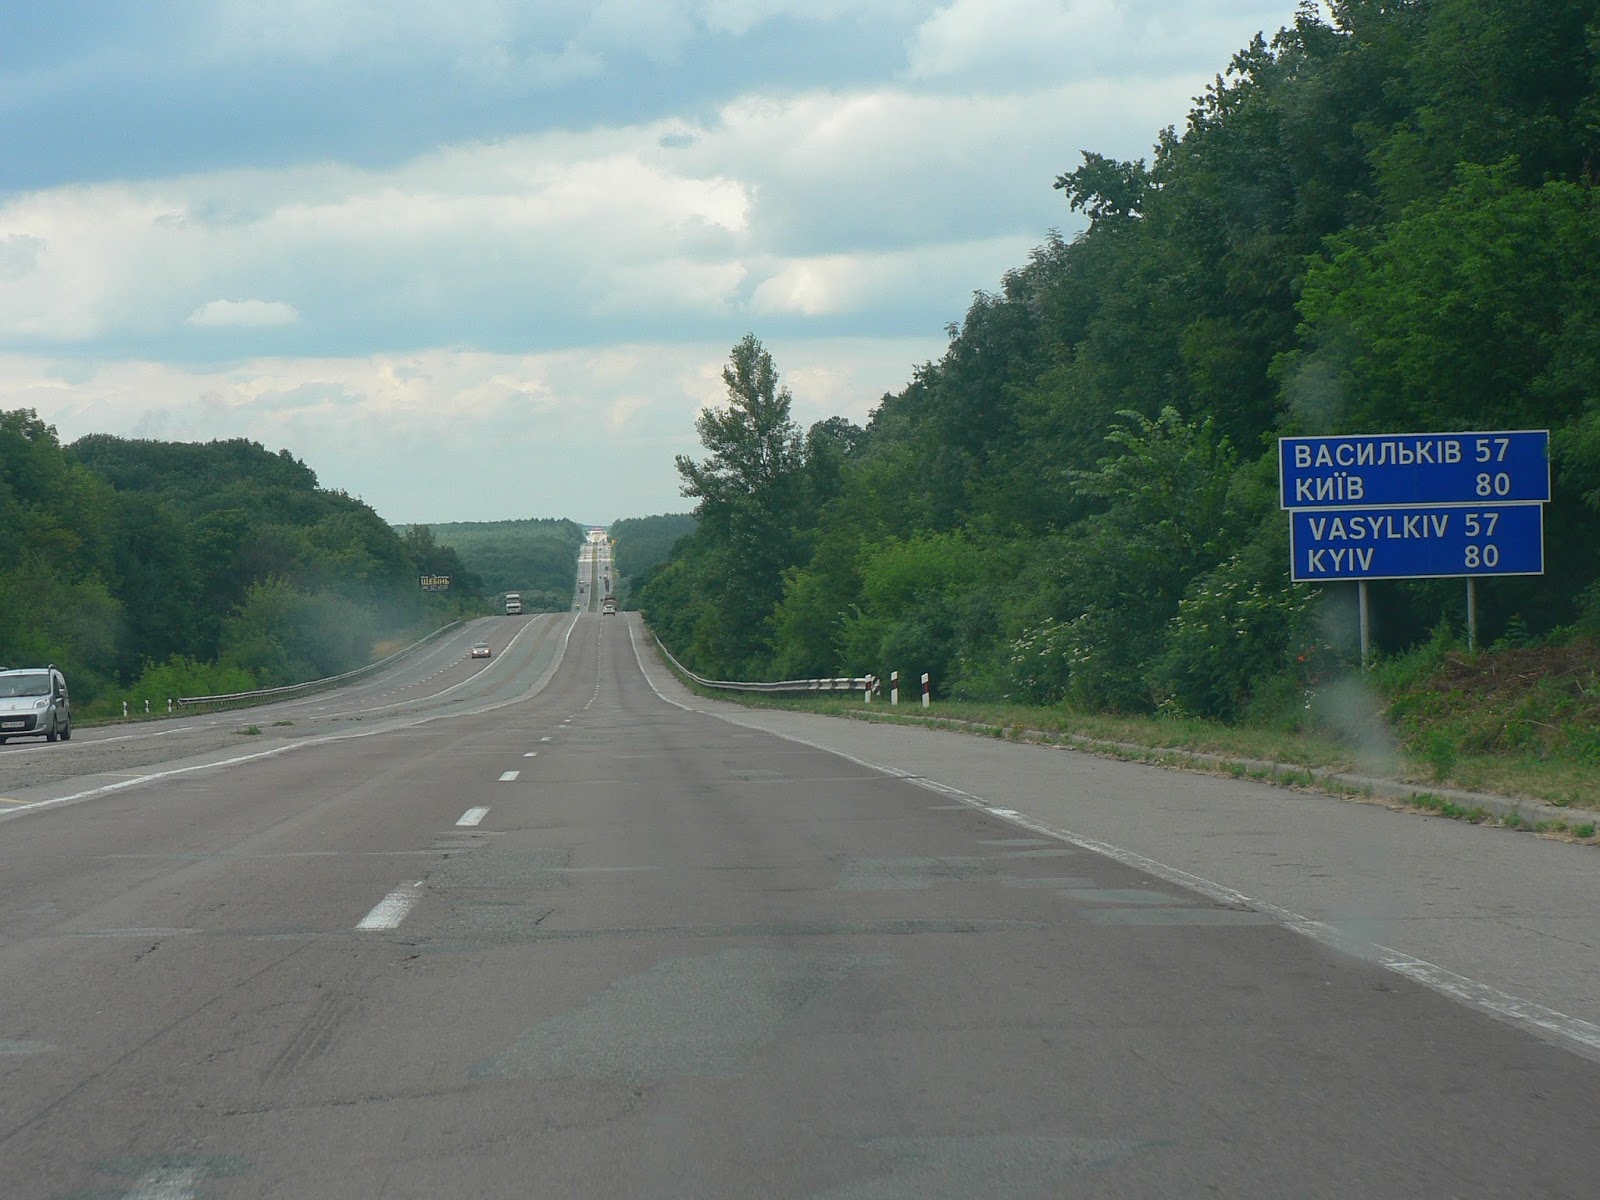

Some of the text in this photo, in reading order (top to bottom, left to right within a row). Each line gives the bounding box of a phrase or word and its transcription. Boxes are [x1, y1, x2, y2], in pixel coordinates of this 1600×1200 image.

[1295, 438, 1510, 468] ВАСИЛЬКІВ 57
[1295, 471, 1511, 501] КИЇВ 80
[1308, 513, 1500, 541] VASYLKIV 57
[1308, 544, 1499, 572] KYIV 80
